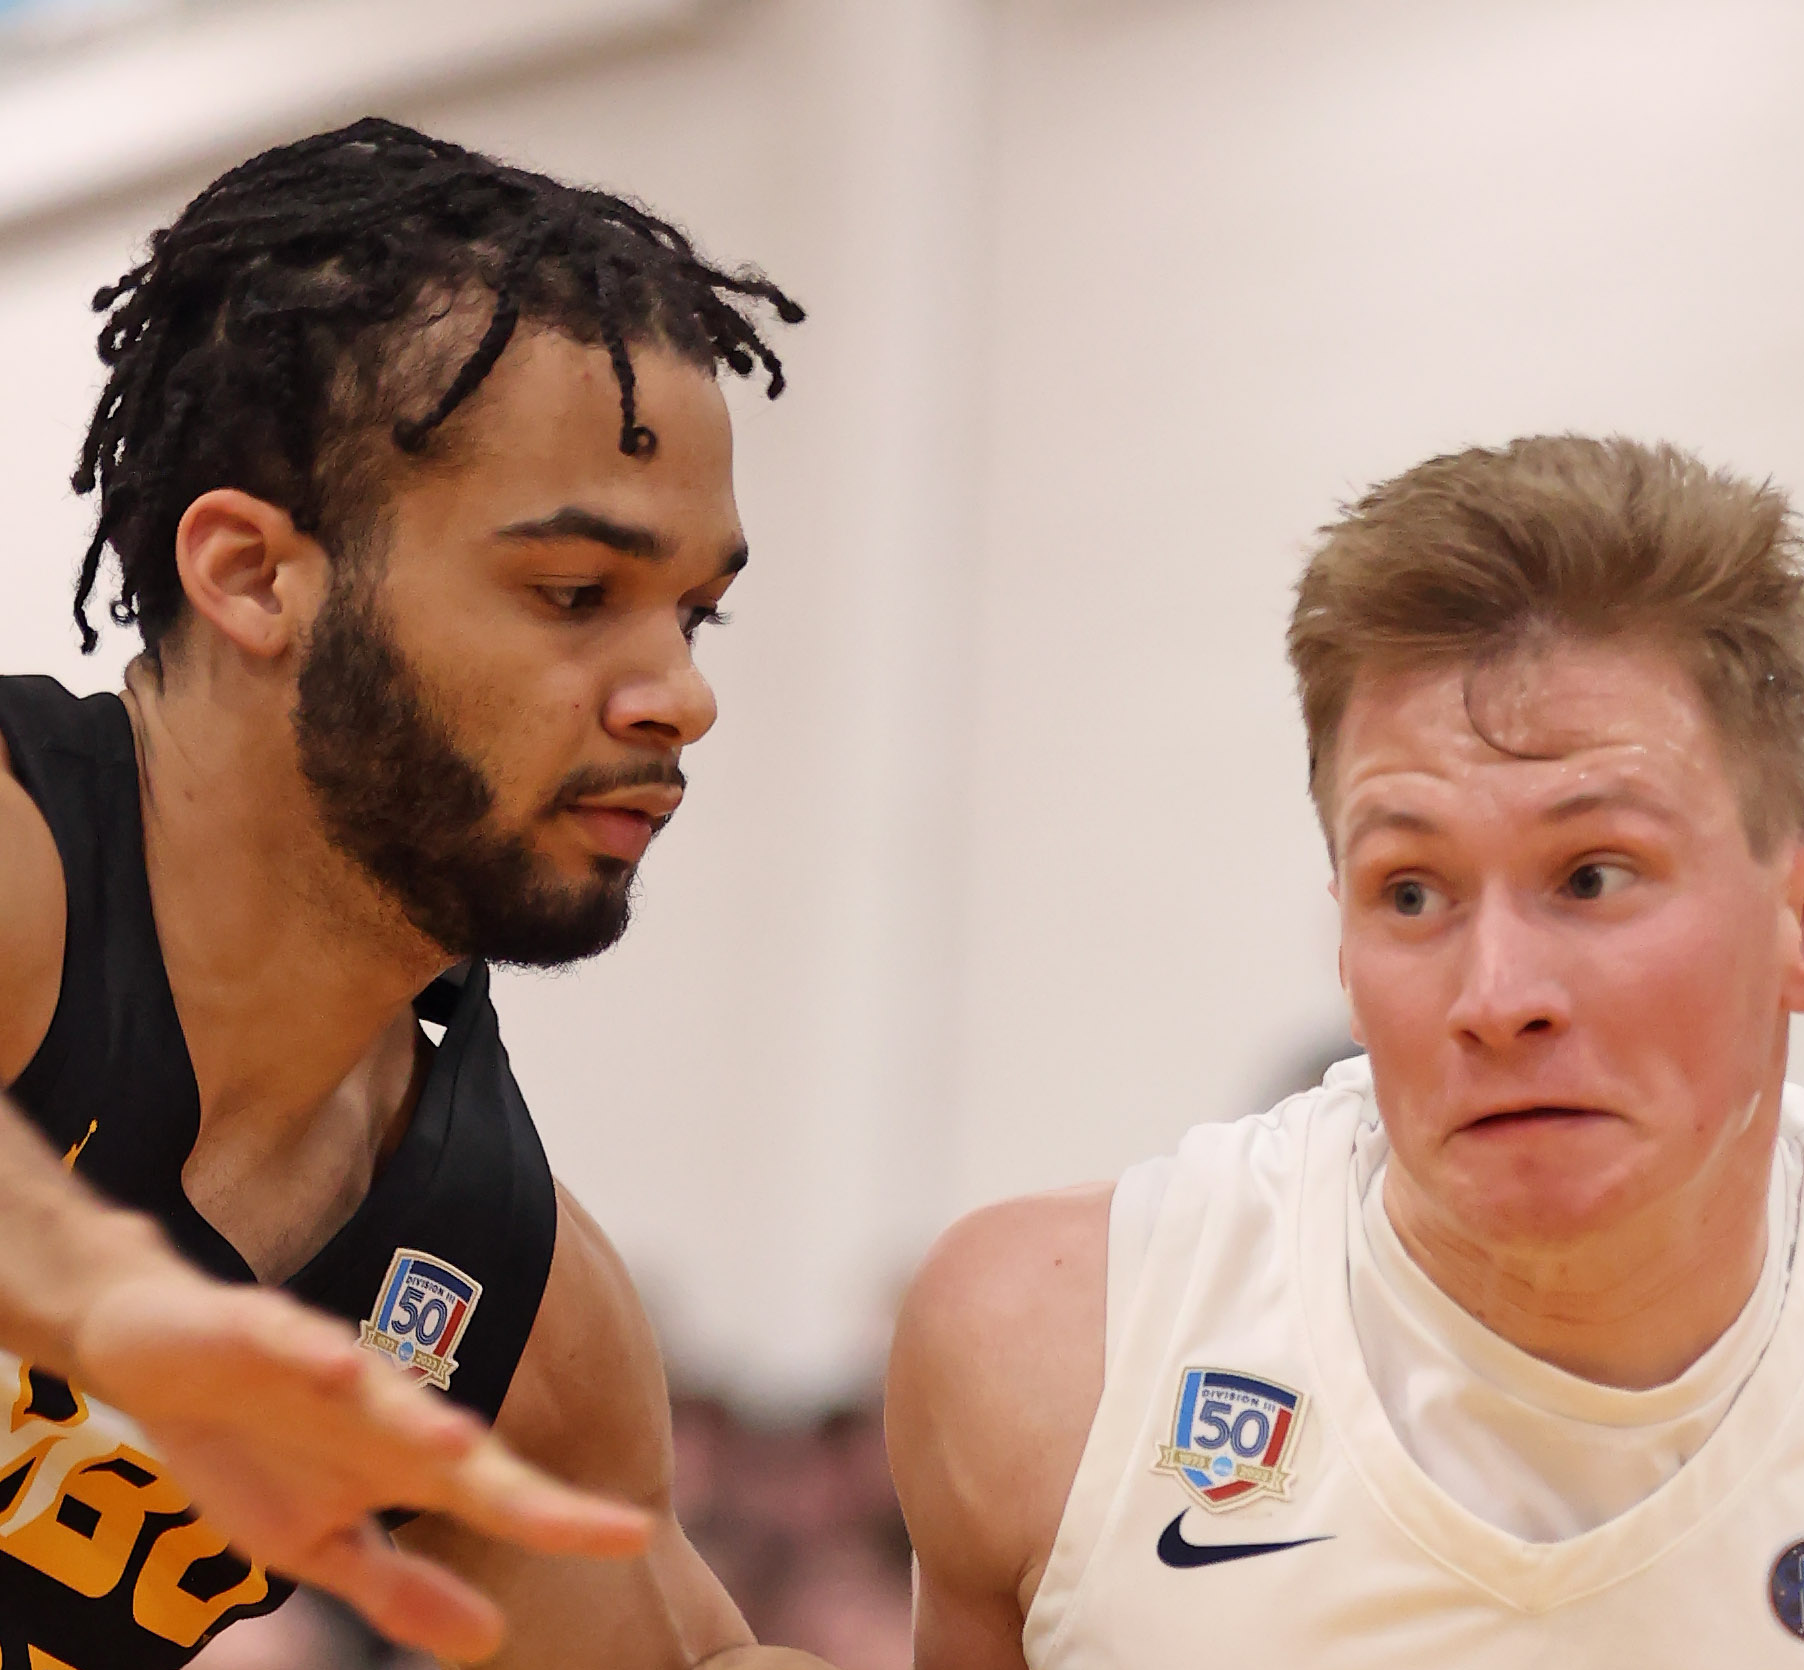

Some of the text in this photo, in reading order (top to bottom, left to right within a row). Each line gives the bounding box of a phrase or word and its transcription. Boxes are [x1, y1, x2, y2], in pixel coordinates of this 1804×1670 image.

[405, 1275, 444, 1298] DIVISION
[391, 1286, 448, 1346] 50
[1201, 1388, 1276, 1413] DIVISION III
[1194, 1400, 1270, 1458] 50
